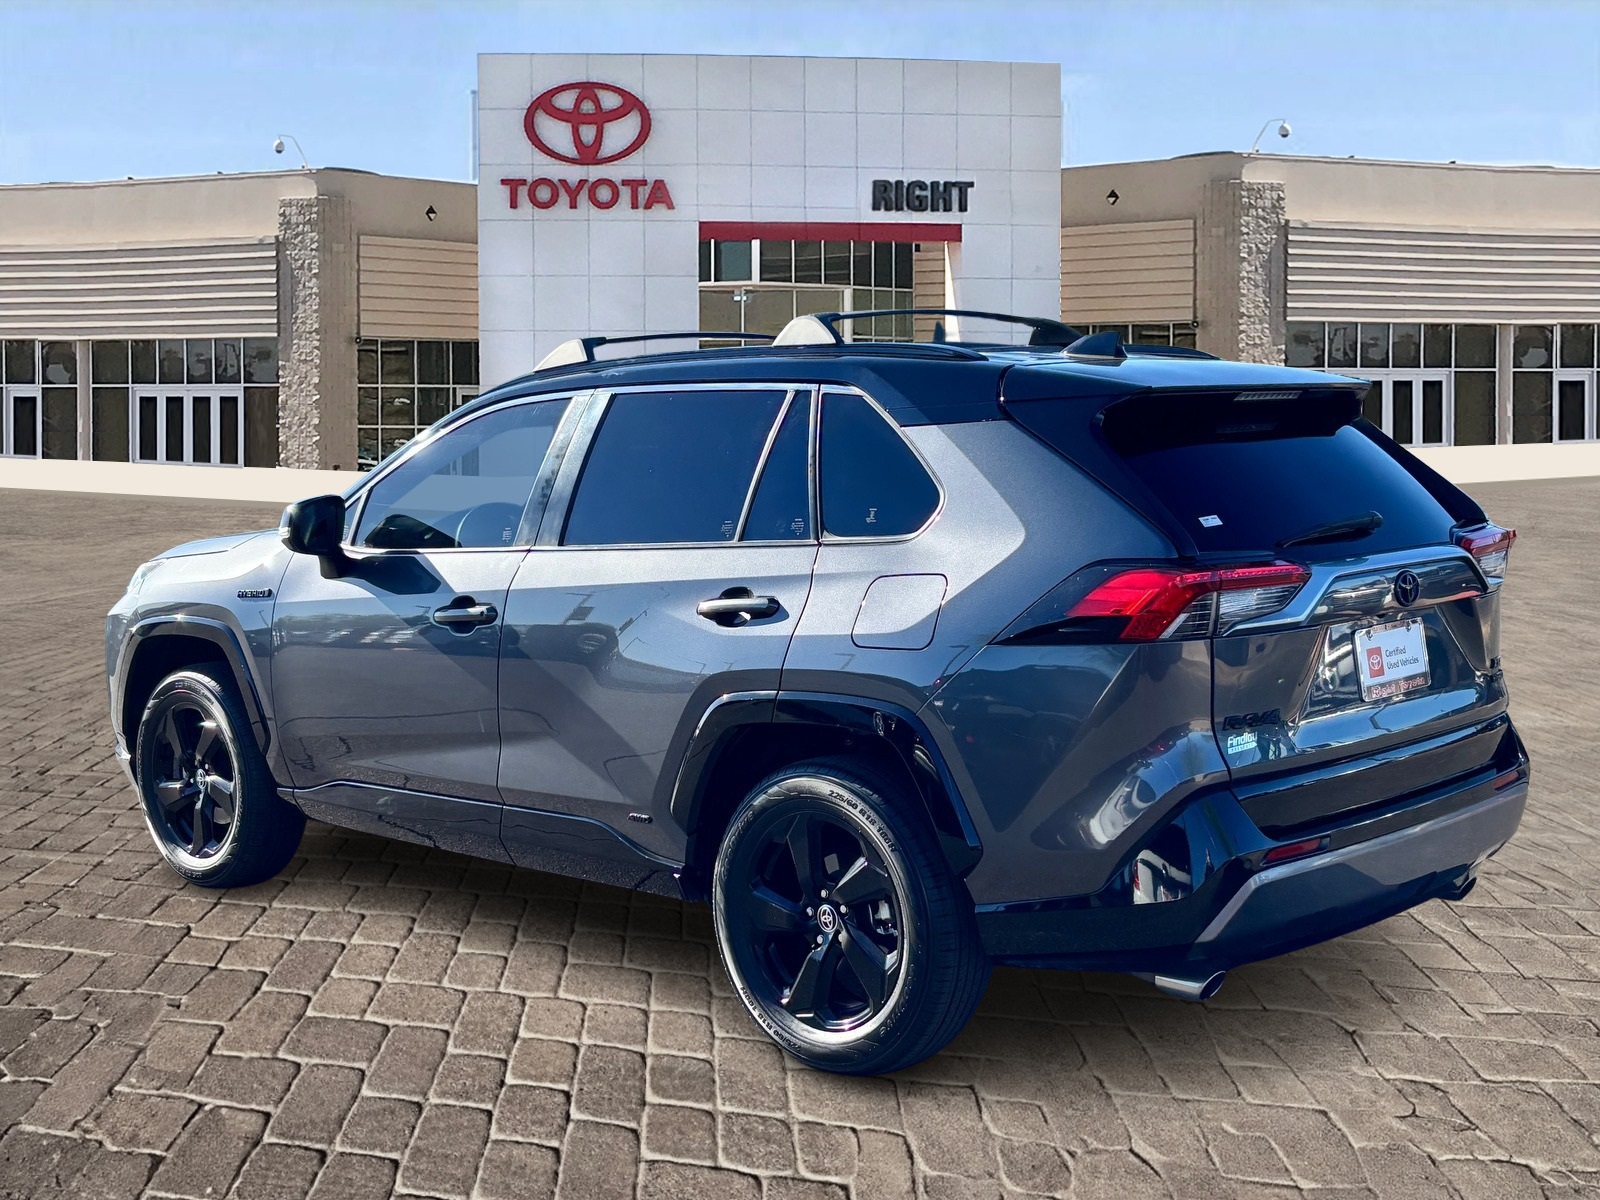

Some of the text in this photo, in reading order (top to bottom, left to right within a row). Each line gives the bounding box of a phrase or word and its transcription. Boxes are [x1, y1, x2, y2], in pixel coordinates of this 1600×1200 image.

[501, 178, 675, 210] TOYOTA
[872, 180, 975, 212] RIGHT
[1385, 645, 1406, 657] Certified
[1387, 656, 1419, 670] Used Vehicles
[828, 789, 859, 810] 225/60
